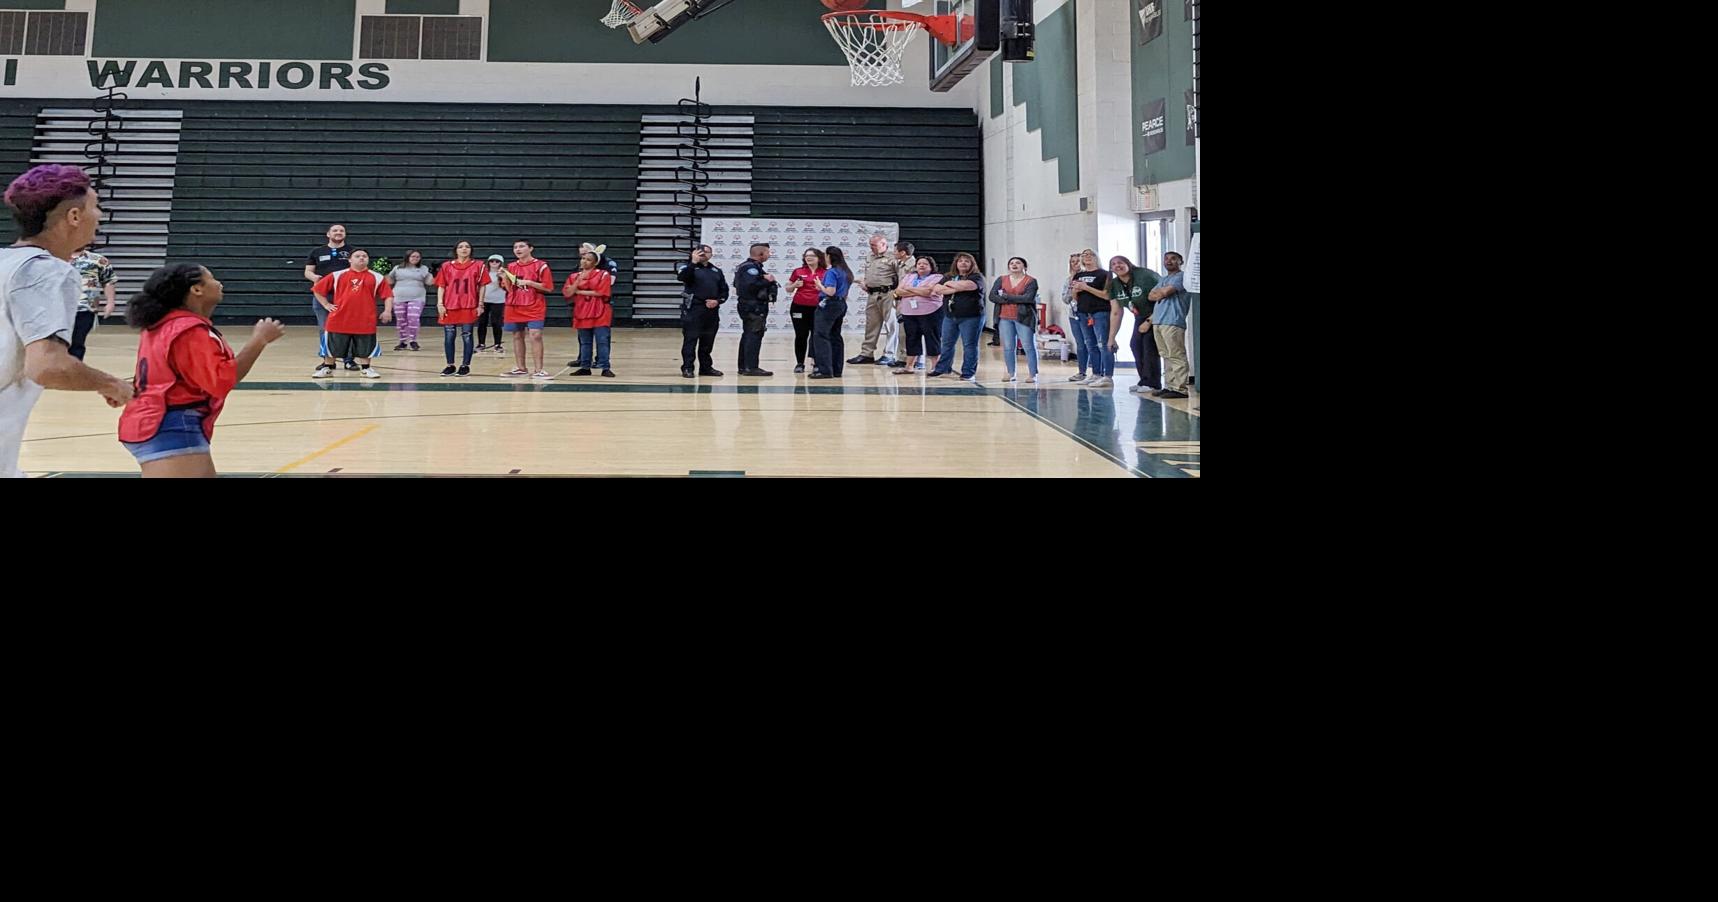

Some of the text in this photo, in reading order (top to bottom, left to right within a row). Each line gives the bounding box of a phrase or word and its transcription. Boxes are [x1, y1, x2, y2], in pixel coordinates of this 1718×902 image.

[87, 60, 390, 90] WARRIORS
[1142, 116, 1163, 131] PEARCE
[453, 279, 469, 294] 11
